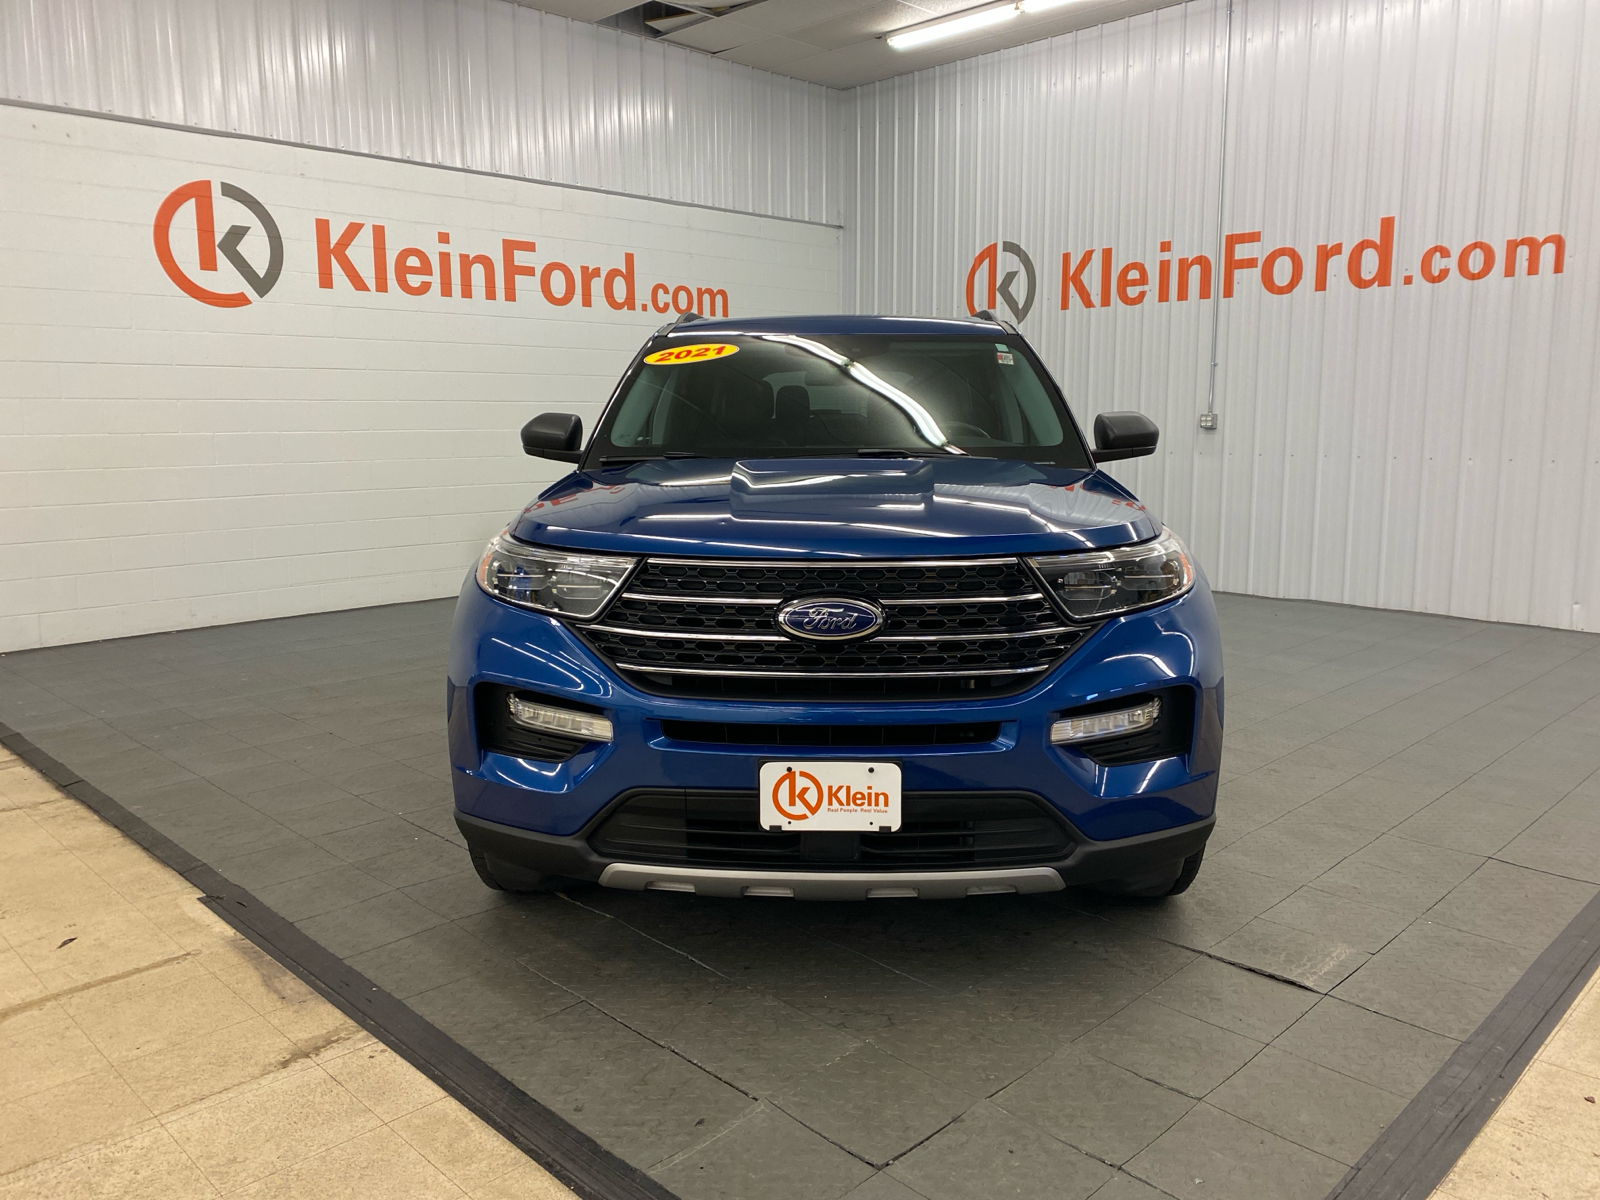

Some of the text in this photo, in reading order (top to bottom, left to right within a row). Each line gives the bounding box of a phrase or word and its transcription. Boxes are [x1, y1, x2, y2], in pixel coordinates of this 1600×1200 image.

[314, 217, 729, 318] KleinFord.com
[1060, 216, 1565, 310] KleinFord.com
[654, 345, 727, 363] 2021
[802, 606, 859, 630] Ford
[827, 785, 890, 807] Klein
